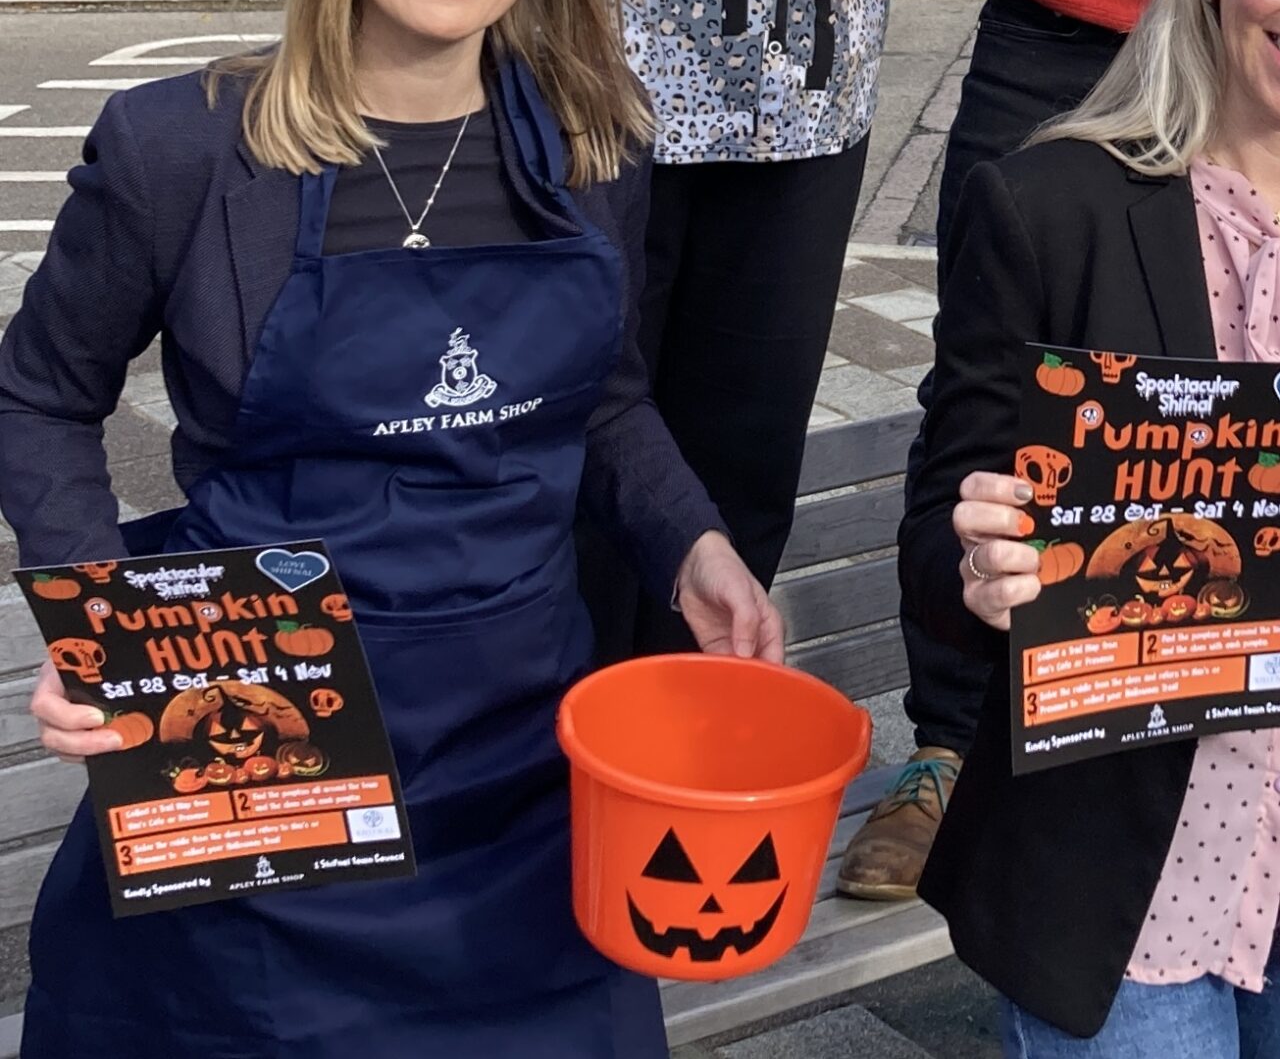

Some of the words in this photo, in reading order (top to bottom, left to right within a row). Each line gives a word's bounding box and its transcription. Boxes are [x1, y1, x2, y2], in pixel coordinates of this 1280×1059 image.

[1136, 371, 1240, 400] Spooktacular
[373, 416, 437, 436] APLEY
[441, 409, 494, 429] FARM
[499, 397, 543, 420] SHOP
[1158, 393, 1214, 418] Shifnal
[1090, 504, 1115, 523] 28
[1232, 500, 1244, 517] 4
[124, 563, 226, 589] Spooktacular
[154, 579, 211, 601] Shifnal
[84, 591, 299, 634] Pumpkin
[1147, 634, 1158, 654] 2
[139, 677, 167, 694] 28
[275, 666, 288, 682] 4
[1027, 692, 1037, 716] 3
[1051, 729, 1093, 748] Sponsored
[1094, 727, 1105, 739] by
[1121, 730, 1145, 742] APLEY
[1147, 727, 1170, 738] FARM
[1172, 723, 1194, 734] SHOP
[238, 793, 250, 811] 2
[120, 845, 133, 866] 3
